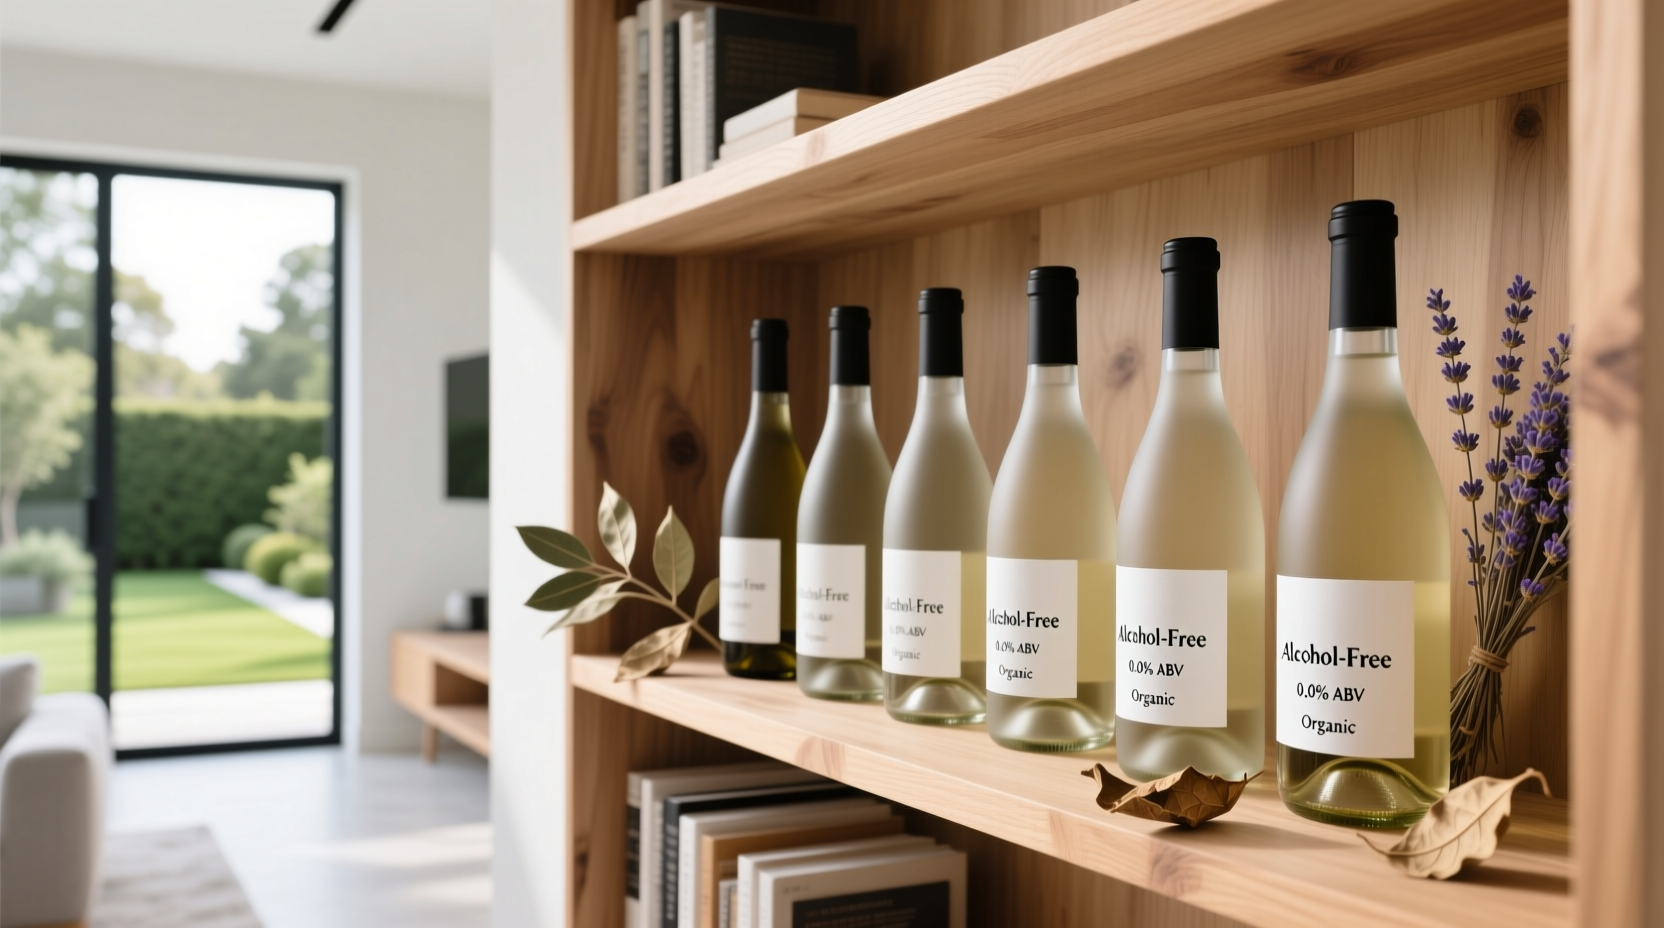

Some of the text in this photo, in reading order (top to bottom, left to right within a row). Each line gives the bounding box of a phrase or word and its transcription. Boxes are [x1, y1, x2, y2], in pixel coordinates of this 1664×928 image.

[1118, 624, 1207, 648] Alcohol-Free
[1017, 643, 1040, 654] ABV
[1281, 641, 1392, 669] Alcohol-Free
[998, 664, 1033, 681] Organic
[1128, 659, 1184, 677] 0.0% ABV
[1131, 688, 1175, 707] Organic
[1296, 682, 1365, 702] 0.0% ABV
[1301, 714, 1357, 735] Organic
